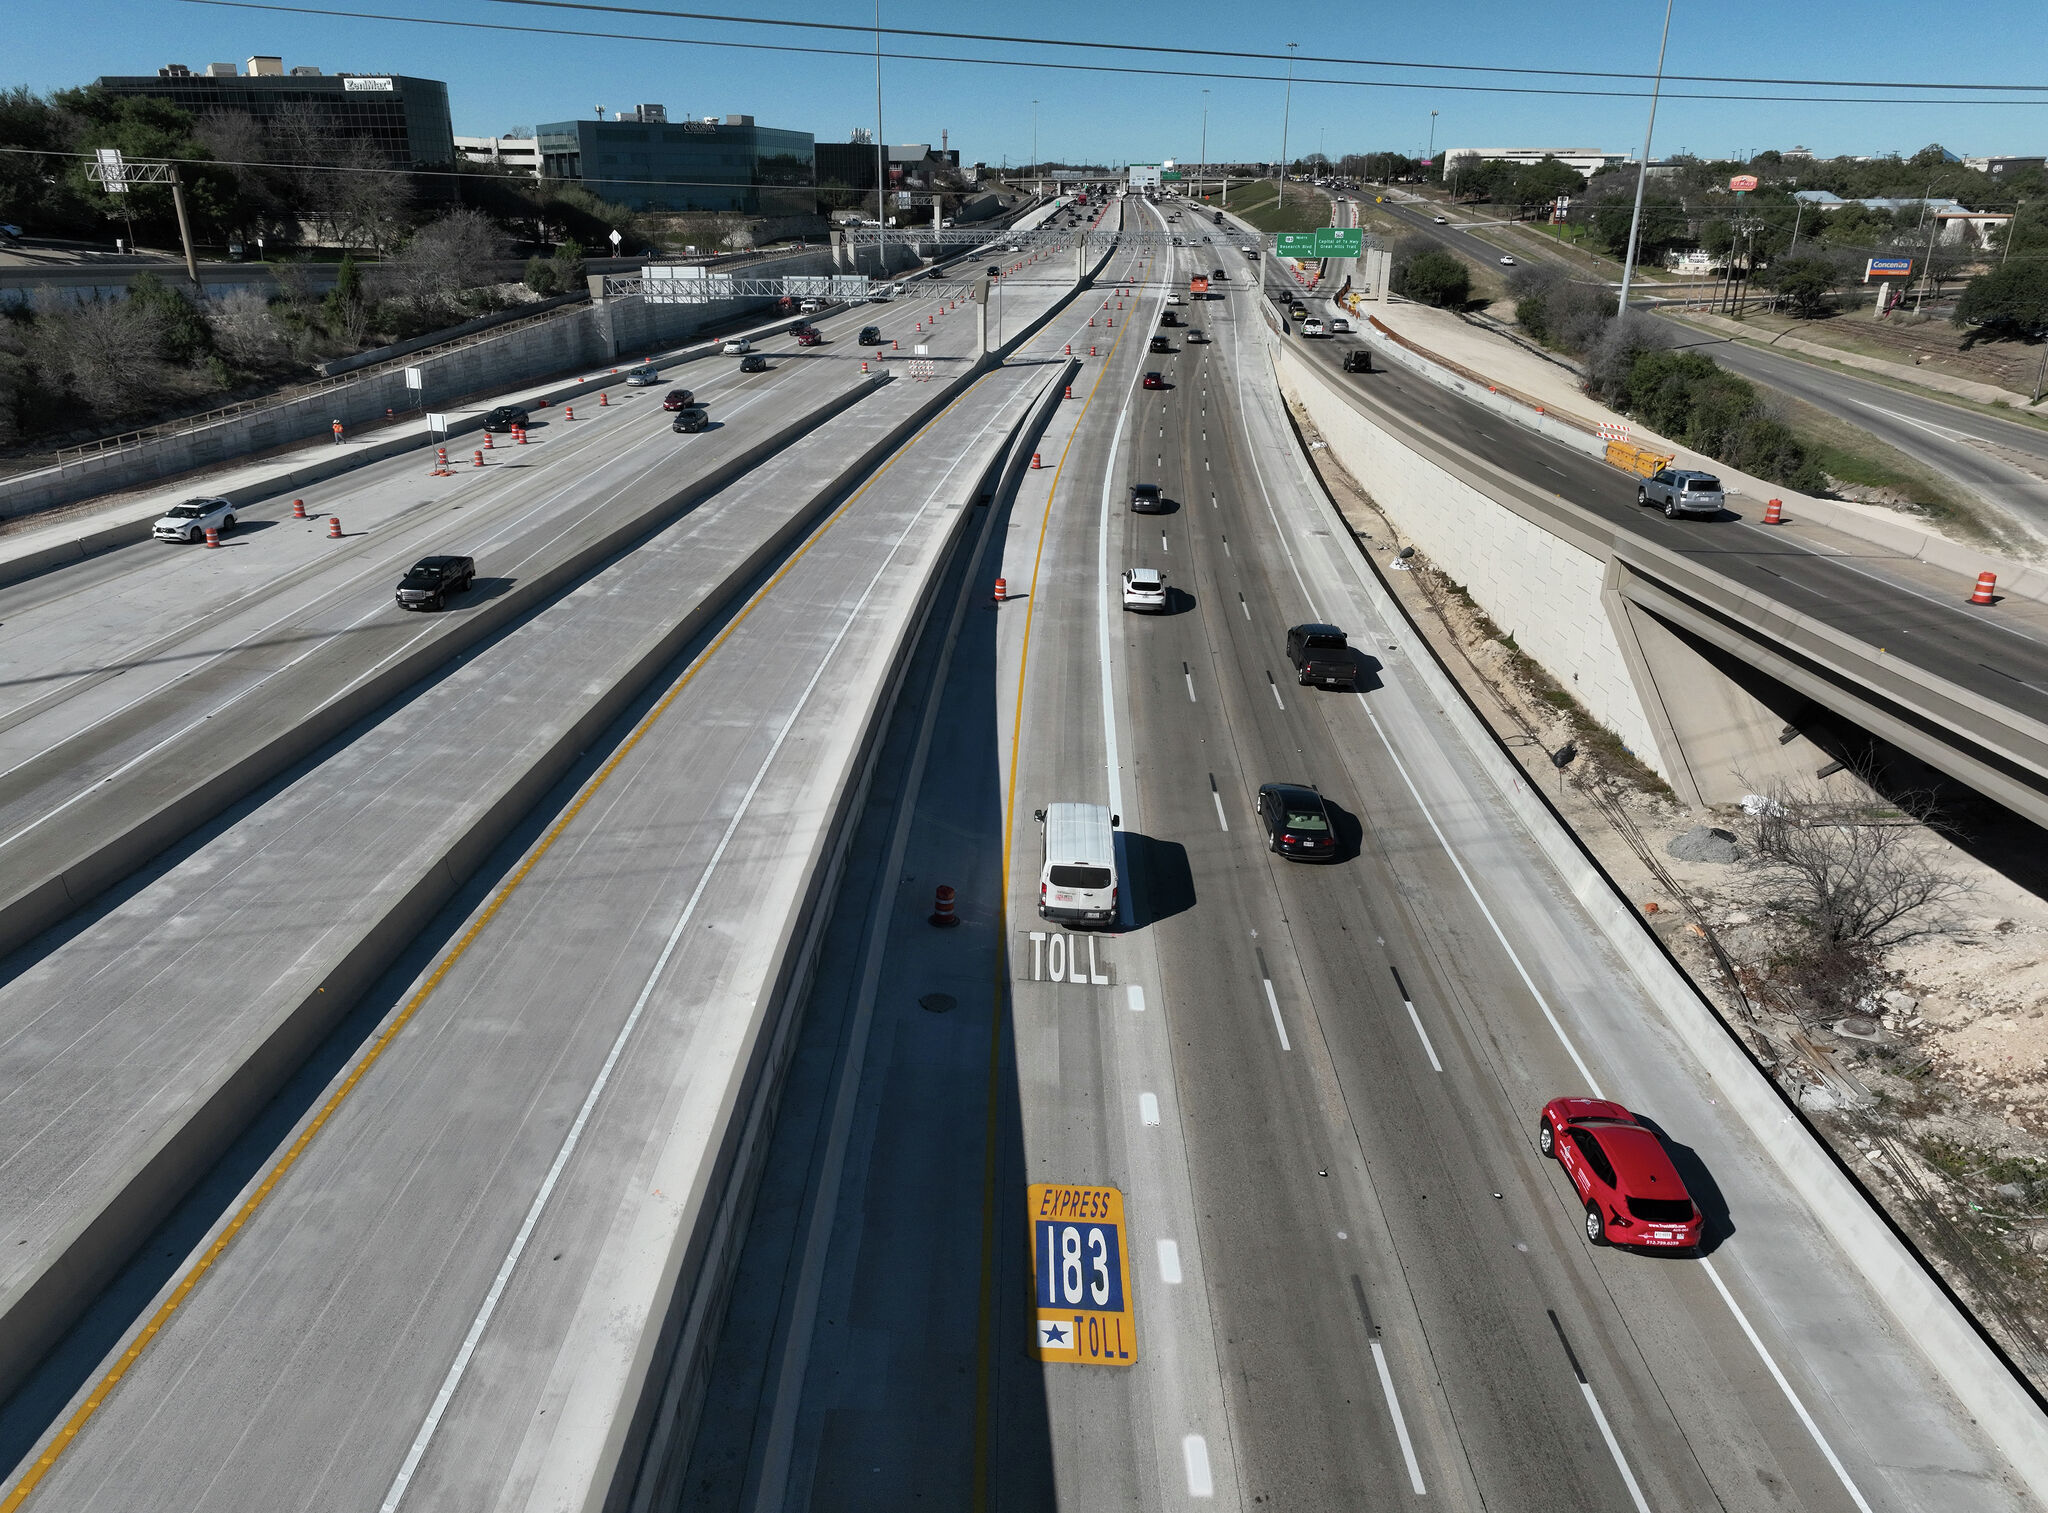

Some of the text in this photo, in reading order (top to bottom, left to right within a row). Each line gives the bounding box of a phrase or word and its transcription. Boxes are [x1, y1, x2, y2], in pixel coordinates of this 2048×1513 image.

[1030, 932, 1108, 985] TOLL
[1040, 1189, 1110, 1218] EXPRESS
[1048, 1225, 1110, 1306] 183
[1074, 1316, 1129, 1359] TOLL
